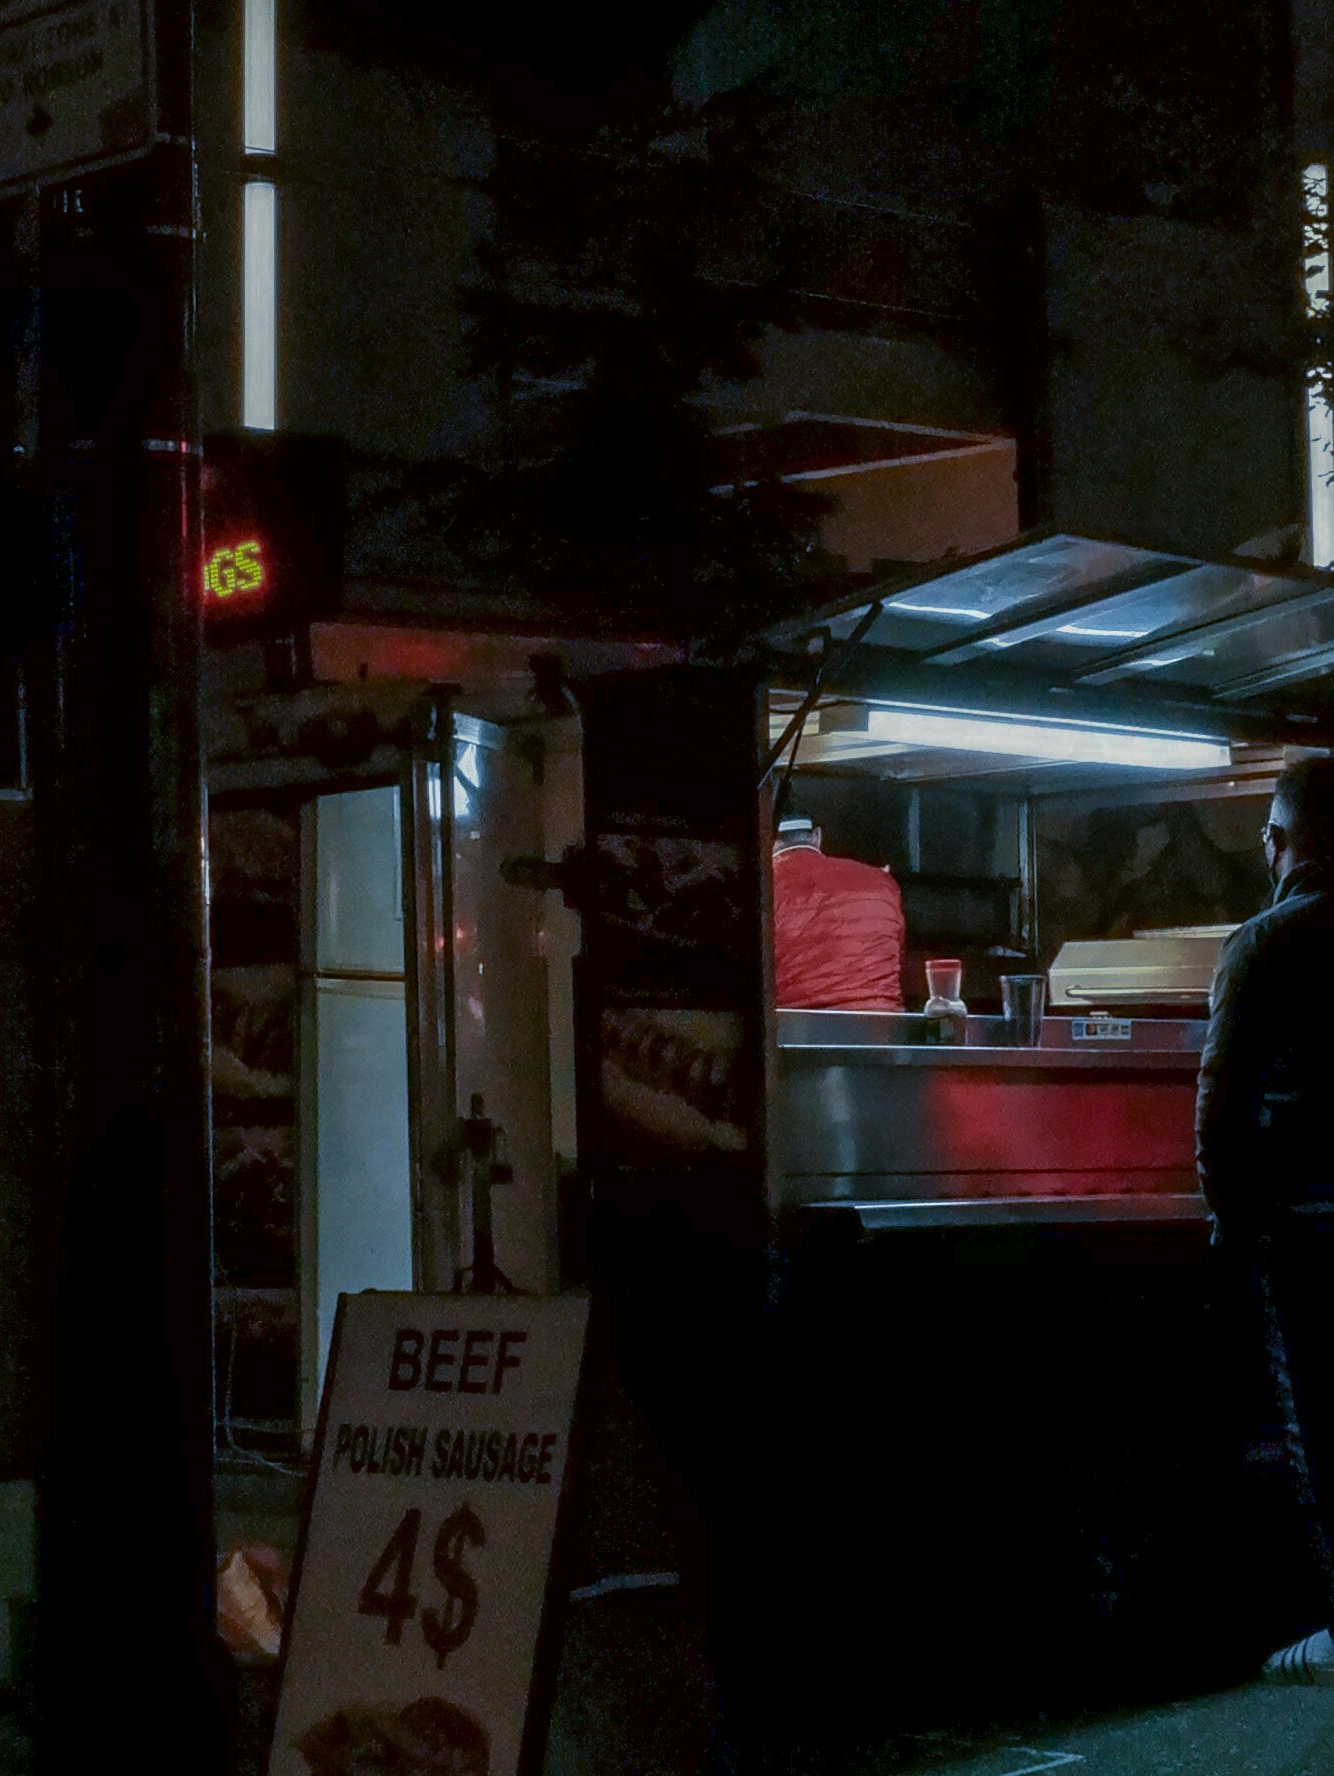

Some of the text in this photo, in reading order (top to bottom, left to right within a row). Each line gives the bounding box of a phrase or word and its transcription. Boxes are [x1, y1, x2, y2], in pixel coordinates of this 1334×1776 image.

[388, 1329, 527, 1394] BEEF
[333, 1422, 556, 1485] POLISH SAUSAGE
[358, 1502, 486, 1670] 4$
